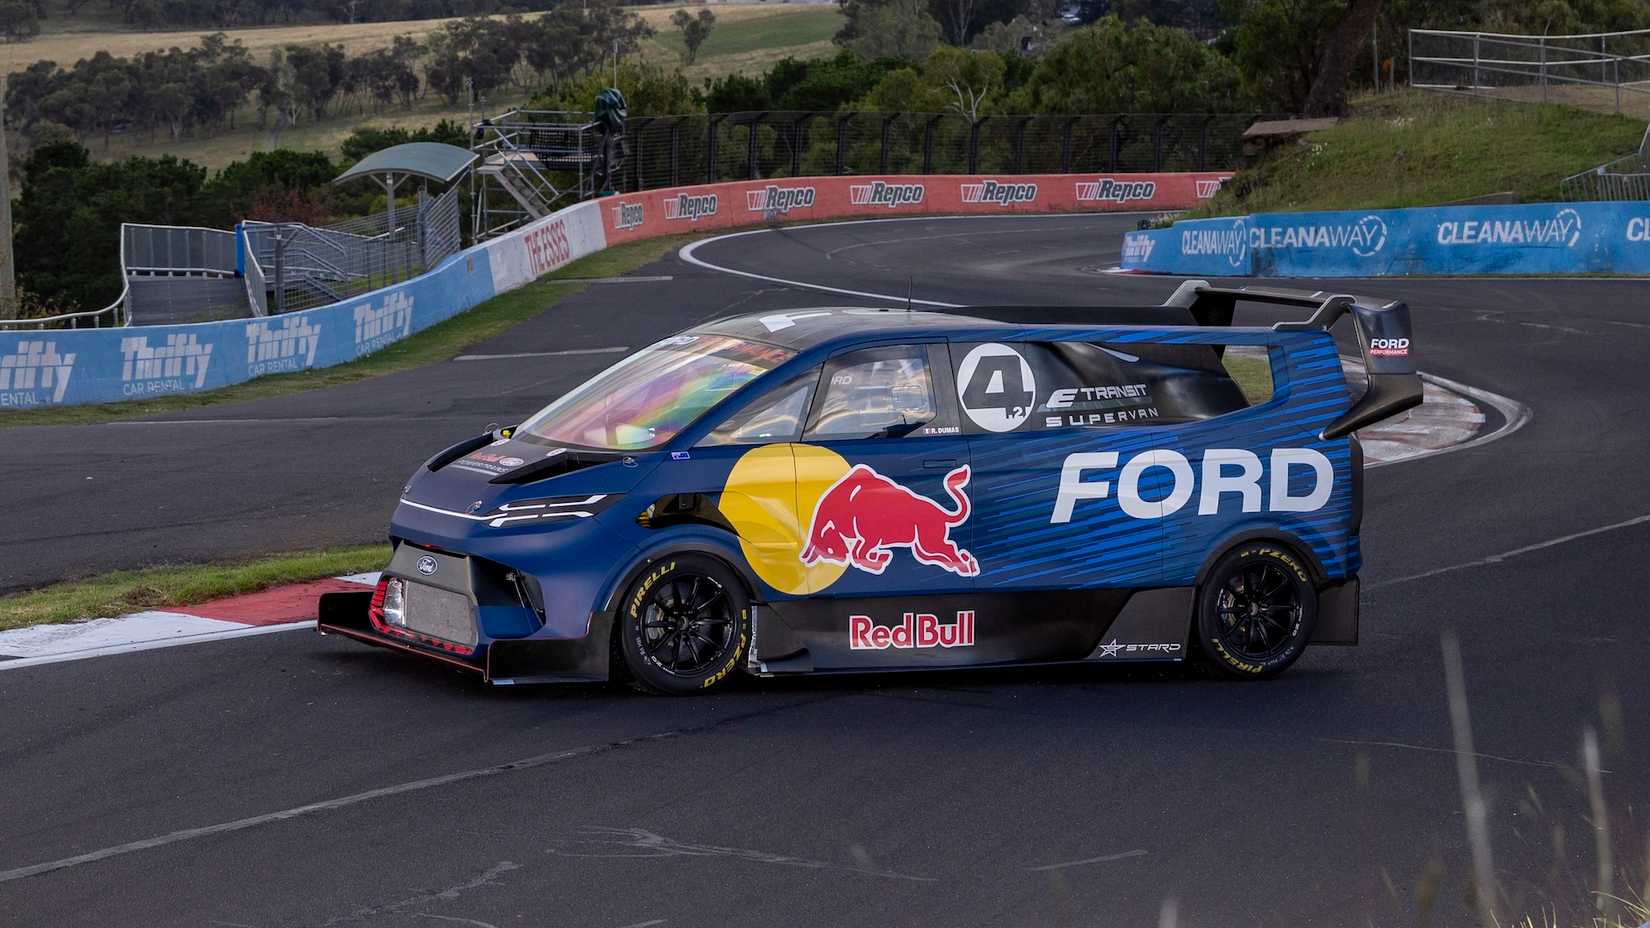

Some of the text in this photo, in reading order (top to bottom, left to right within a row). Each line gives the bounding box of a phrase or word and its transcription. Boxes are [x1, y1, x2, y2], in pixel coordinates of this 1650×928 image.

[766, 185, 815, 213] Repco
[870, 181, 925, 208] Repco
[980, 180, 1038, 206] Repco
[1098, 178, 1156, 203] Repco
[621, 203, 644, 230] Repco
[678, 193, 718, 221] Repco
[1182, 230, 1242, 255] CLEANAWAY
[1249, 225, 1378, 248] CLEANAWAY
[1437, 219, 1573, 245] CLEANAWAY
[524, 219, 570, 274] THE ESSES
[353, 290, 415, 345] Thrifty
[246, 316, 321, 366] Thrifty
[1370, 338, 1410, 349] FORD
[121, 334, 214, 389] Thrifty
[123, 379, 185, 396] CAR RENTAL
[1080, 383, 1148, 401] TRANSIT
[1046, 407, 1160, 427] SUPERVAN
[1050, 448, 1334, 524] FORD
[630, 561, 676, 618] PIRELLI
[849, 610, 975, 650] Red Bull
[1126, 643, 1181, 653] STARD
